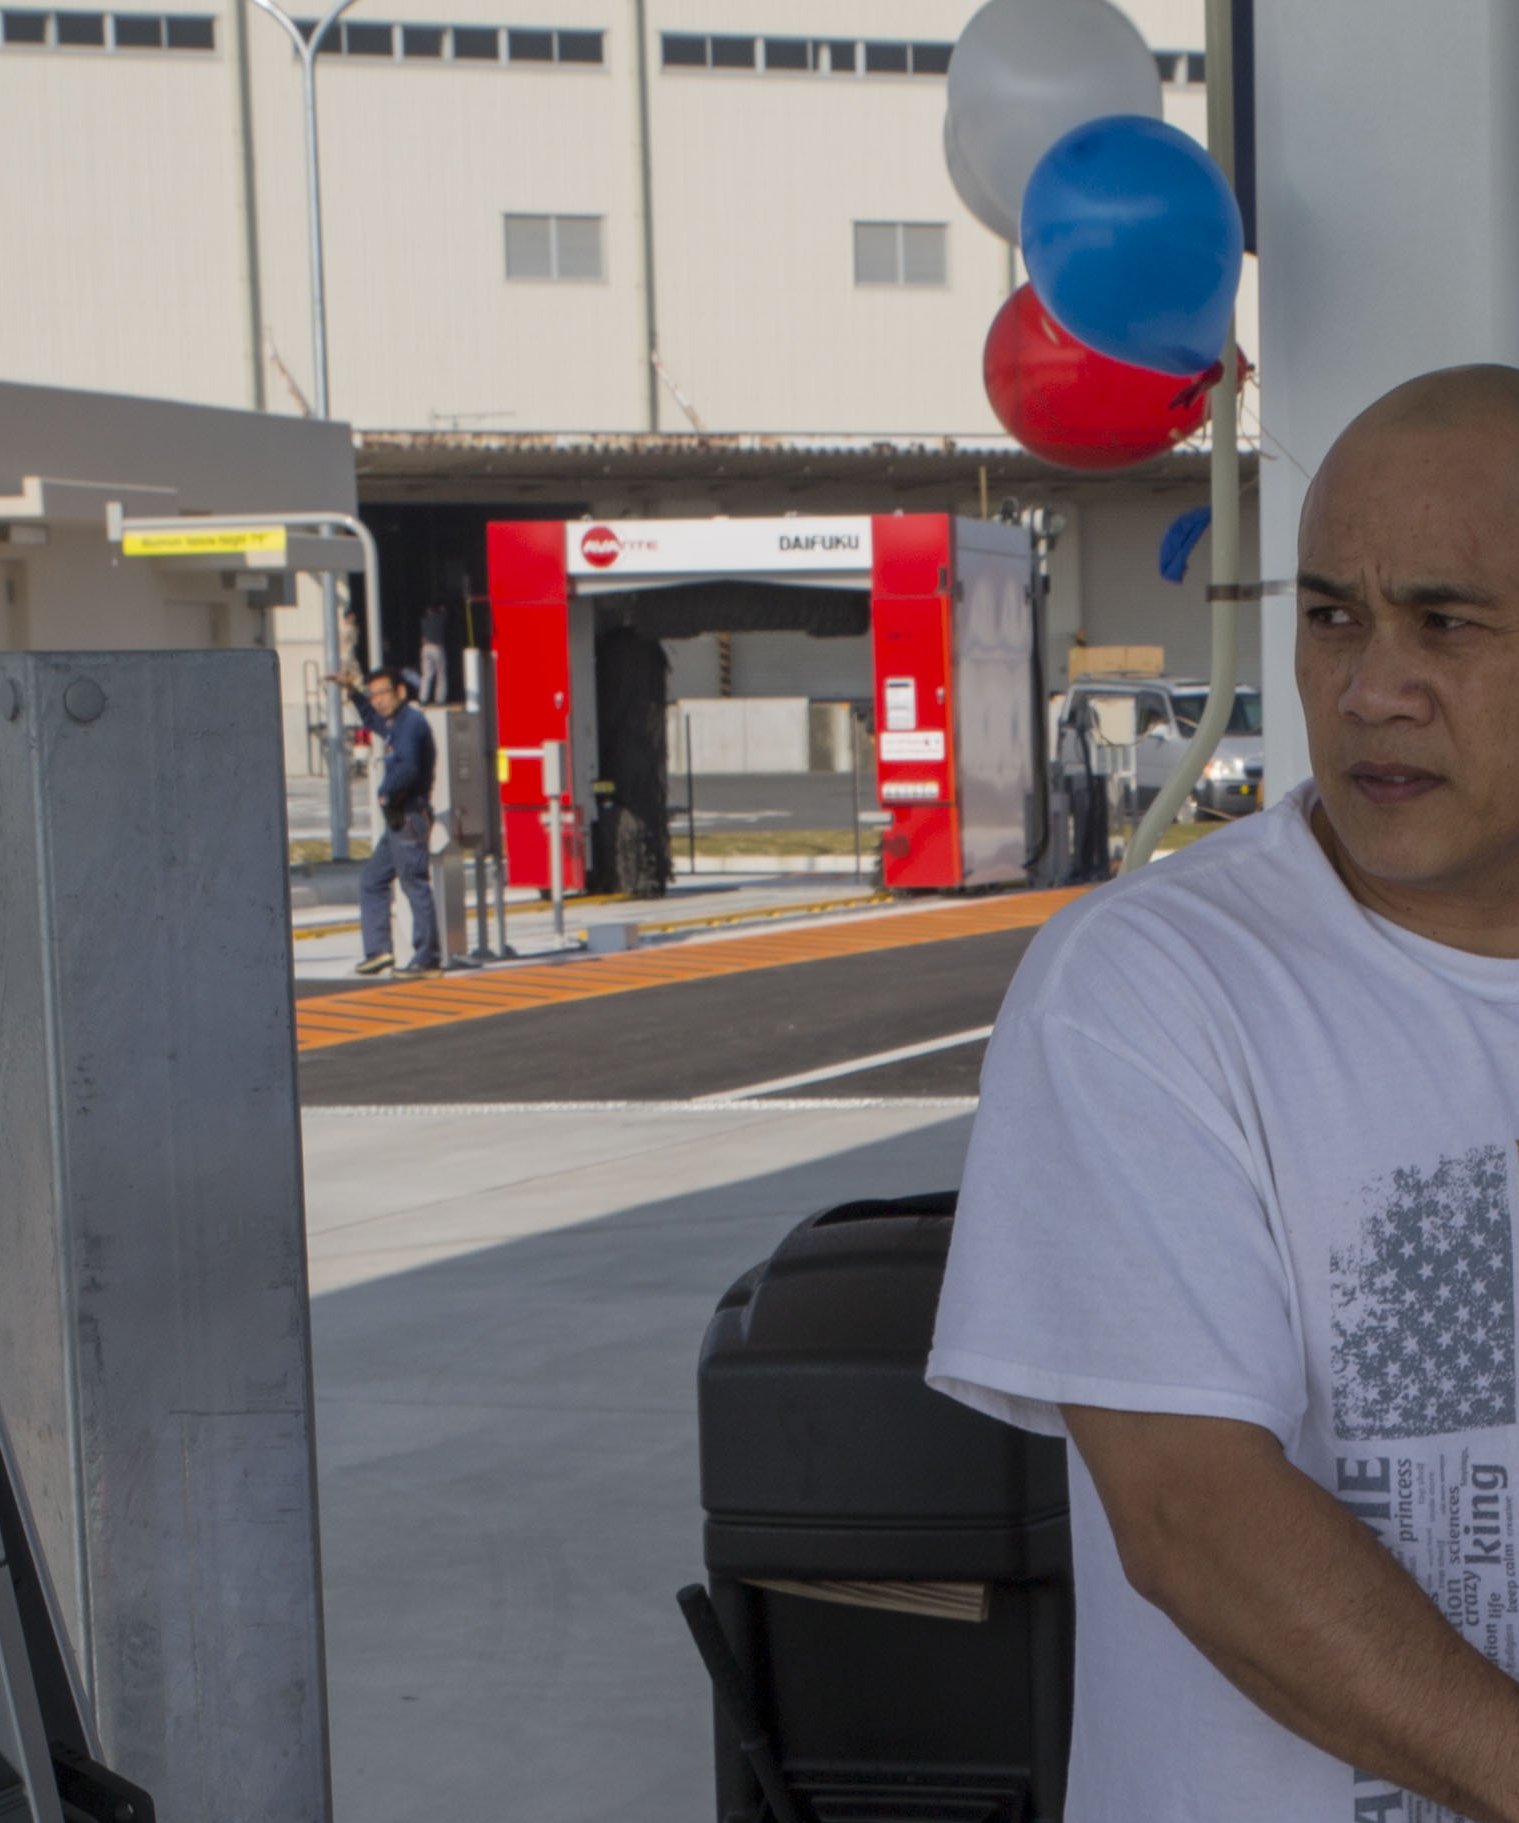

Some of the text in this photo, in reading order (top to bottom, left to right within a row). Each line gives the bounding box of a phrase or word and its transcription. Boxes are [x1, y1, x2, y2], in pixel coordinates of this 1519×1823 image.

[779, 534, 860, 552] DAIFUKU
[1394, 1458, 1419, 1543] princess
[1447, 1486, 1461, 1565] sciences
[1464, 1464, 1508, 1565] king
[1462, 1570, 1481, 1627] crazy
[1488, 1592, 1505, 1619] life
[1502, 1543, 1519, 1613] keep calm
